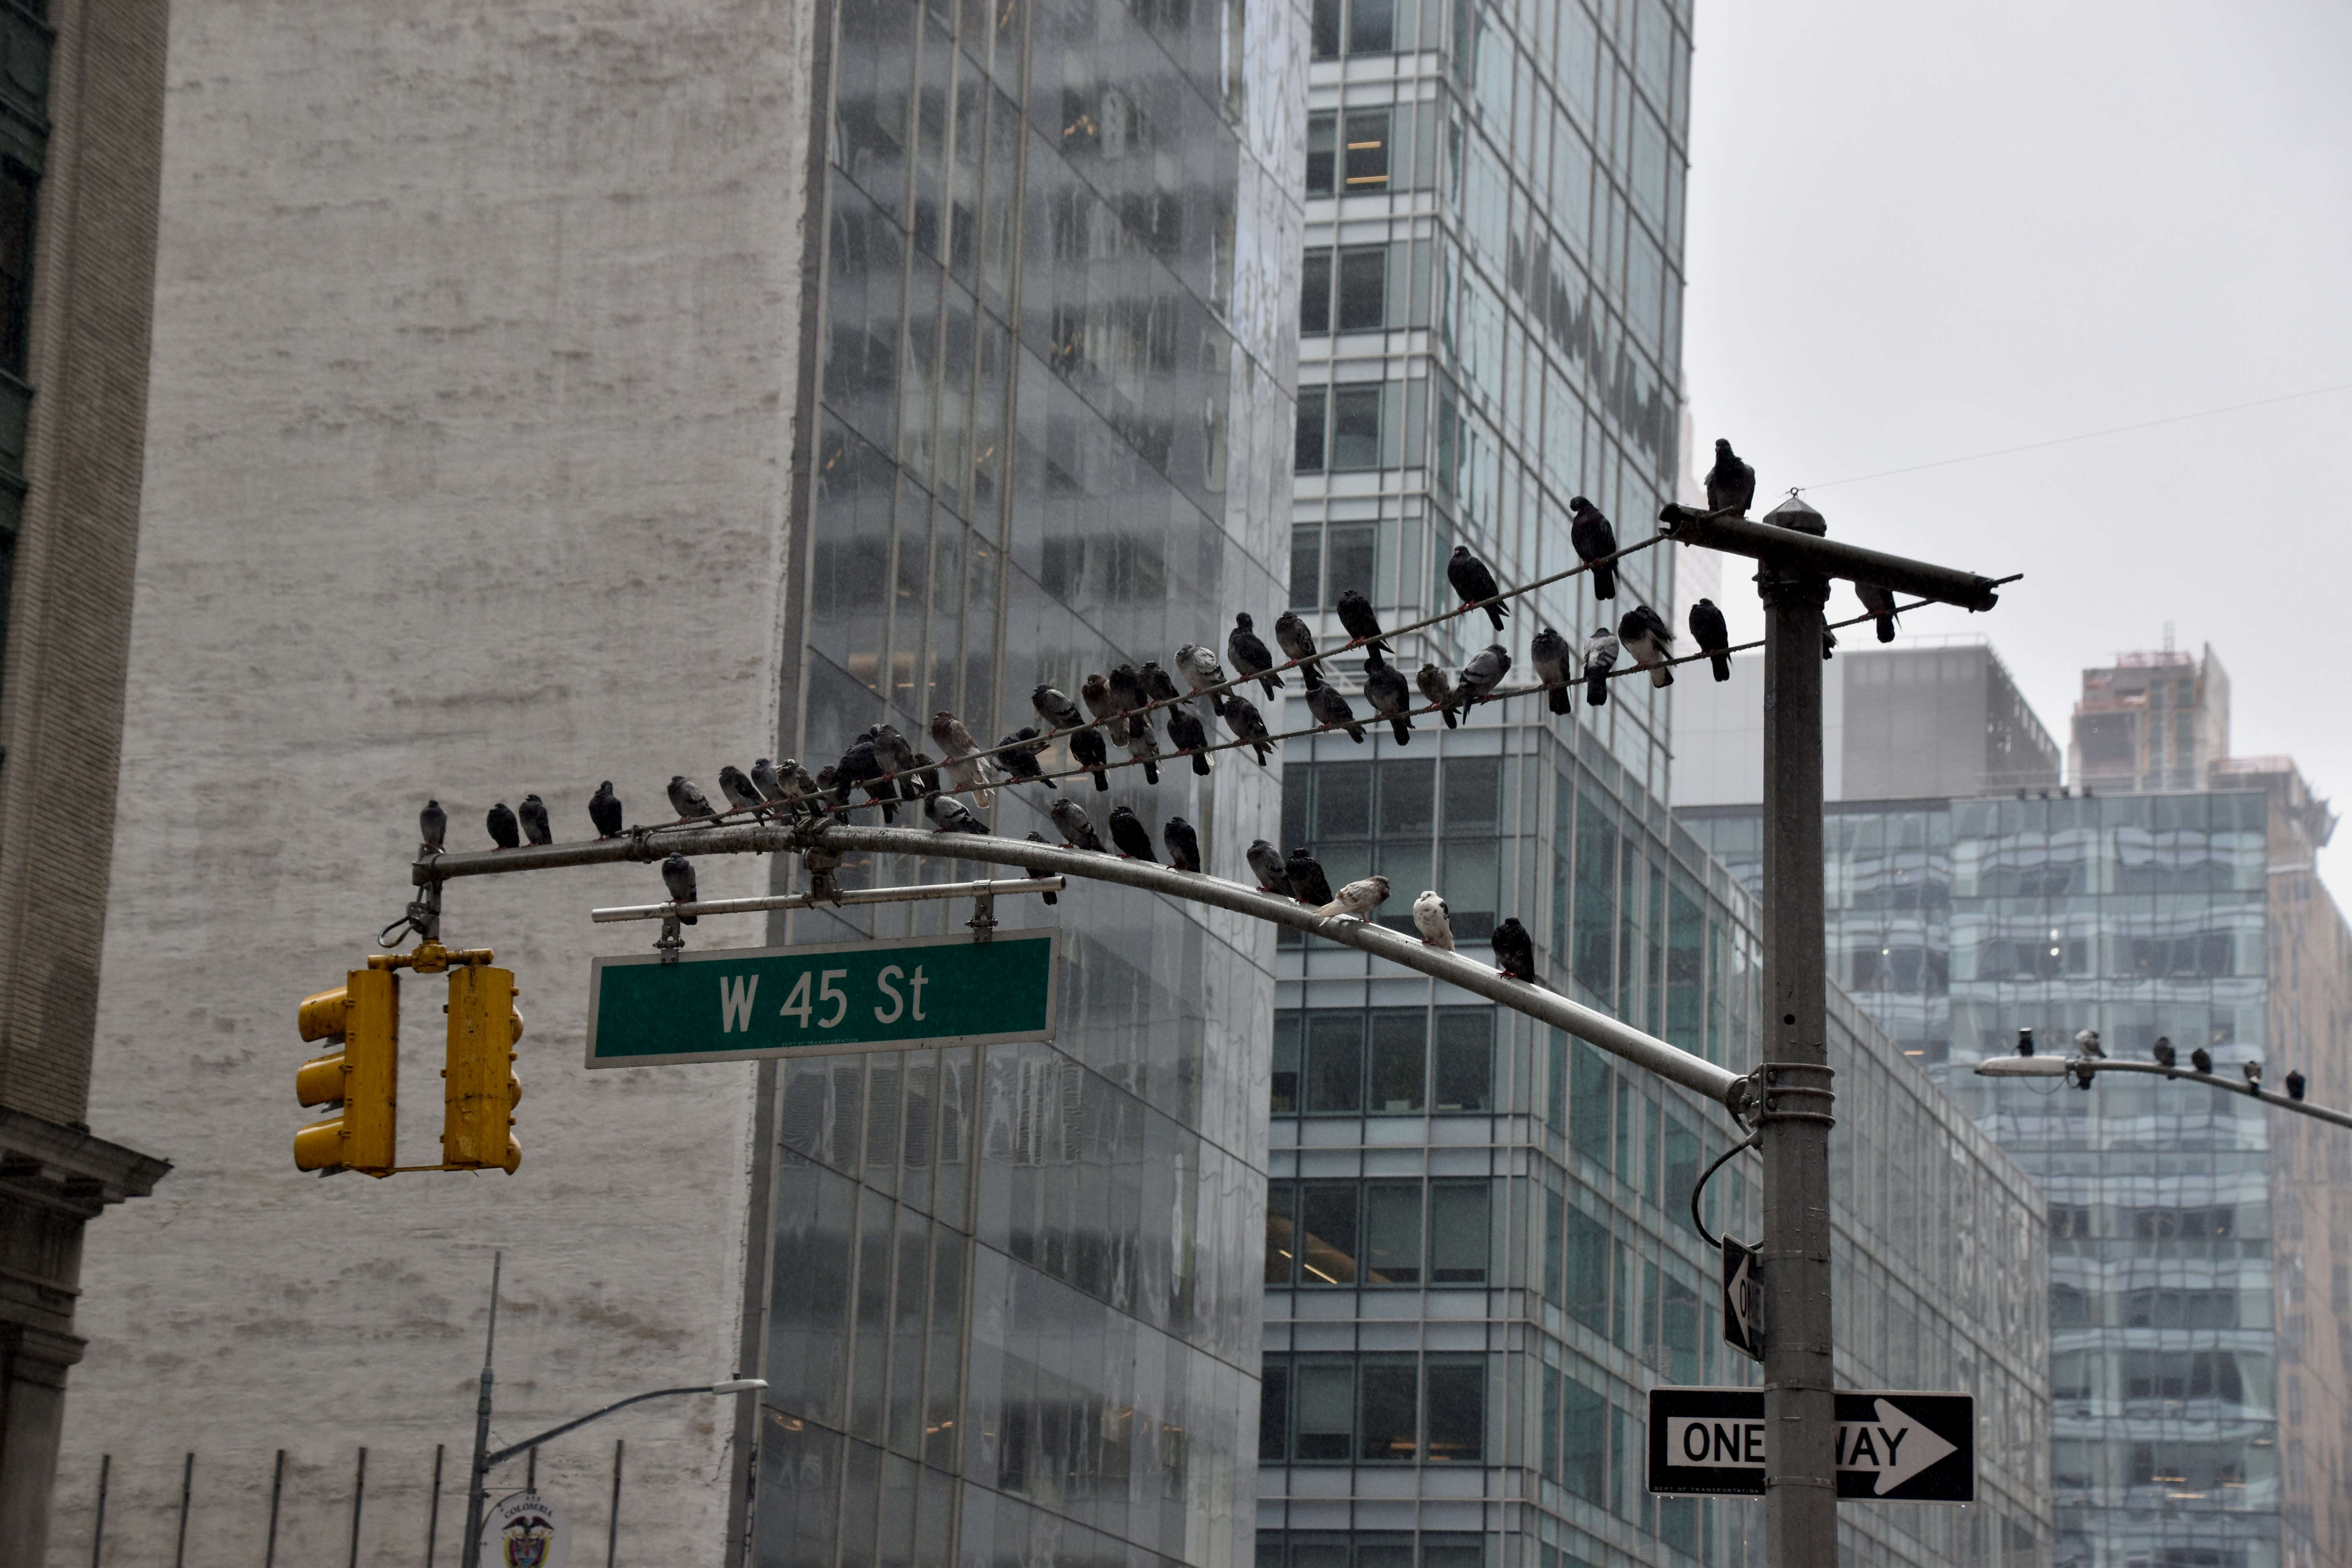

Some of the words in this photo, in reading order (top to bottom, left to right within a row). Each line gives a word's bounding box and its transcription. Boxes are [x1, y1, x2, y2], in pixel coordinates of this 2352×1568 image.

[720, 975, 759, 1033] W
[780, 969, 847, 1028] 45
[874, 964, 929, 1024] St
[1684, 1423, 1765, 1463] ONE
[505, 1503, 552, 1518] COLOMBIA
